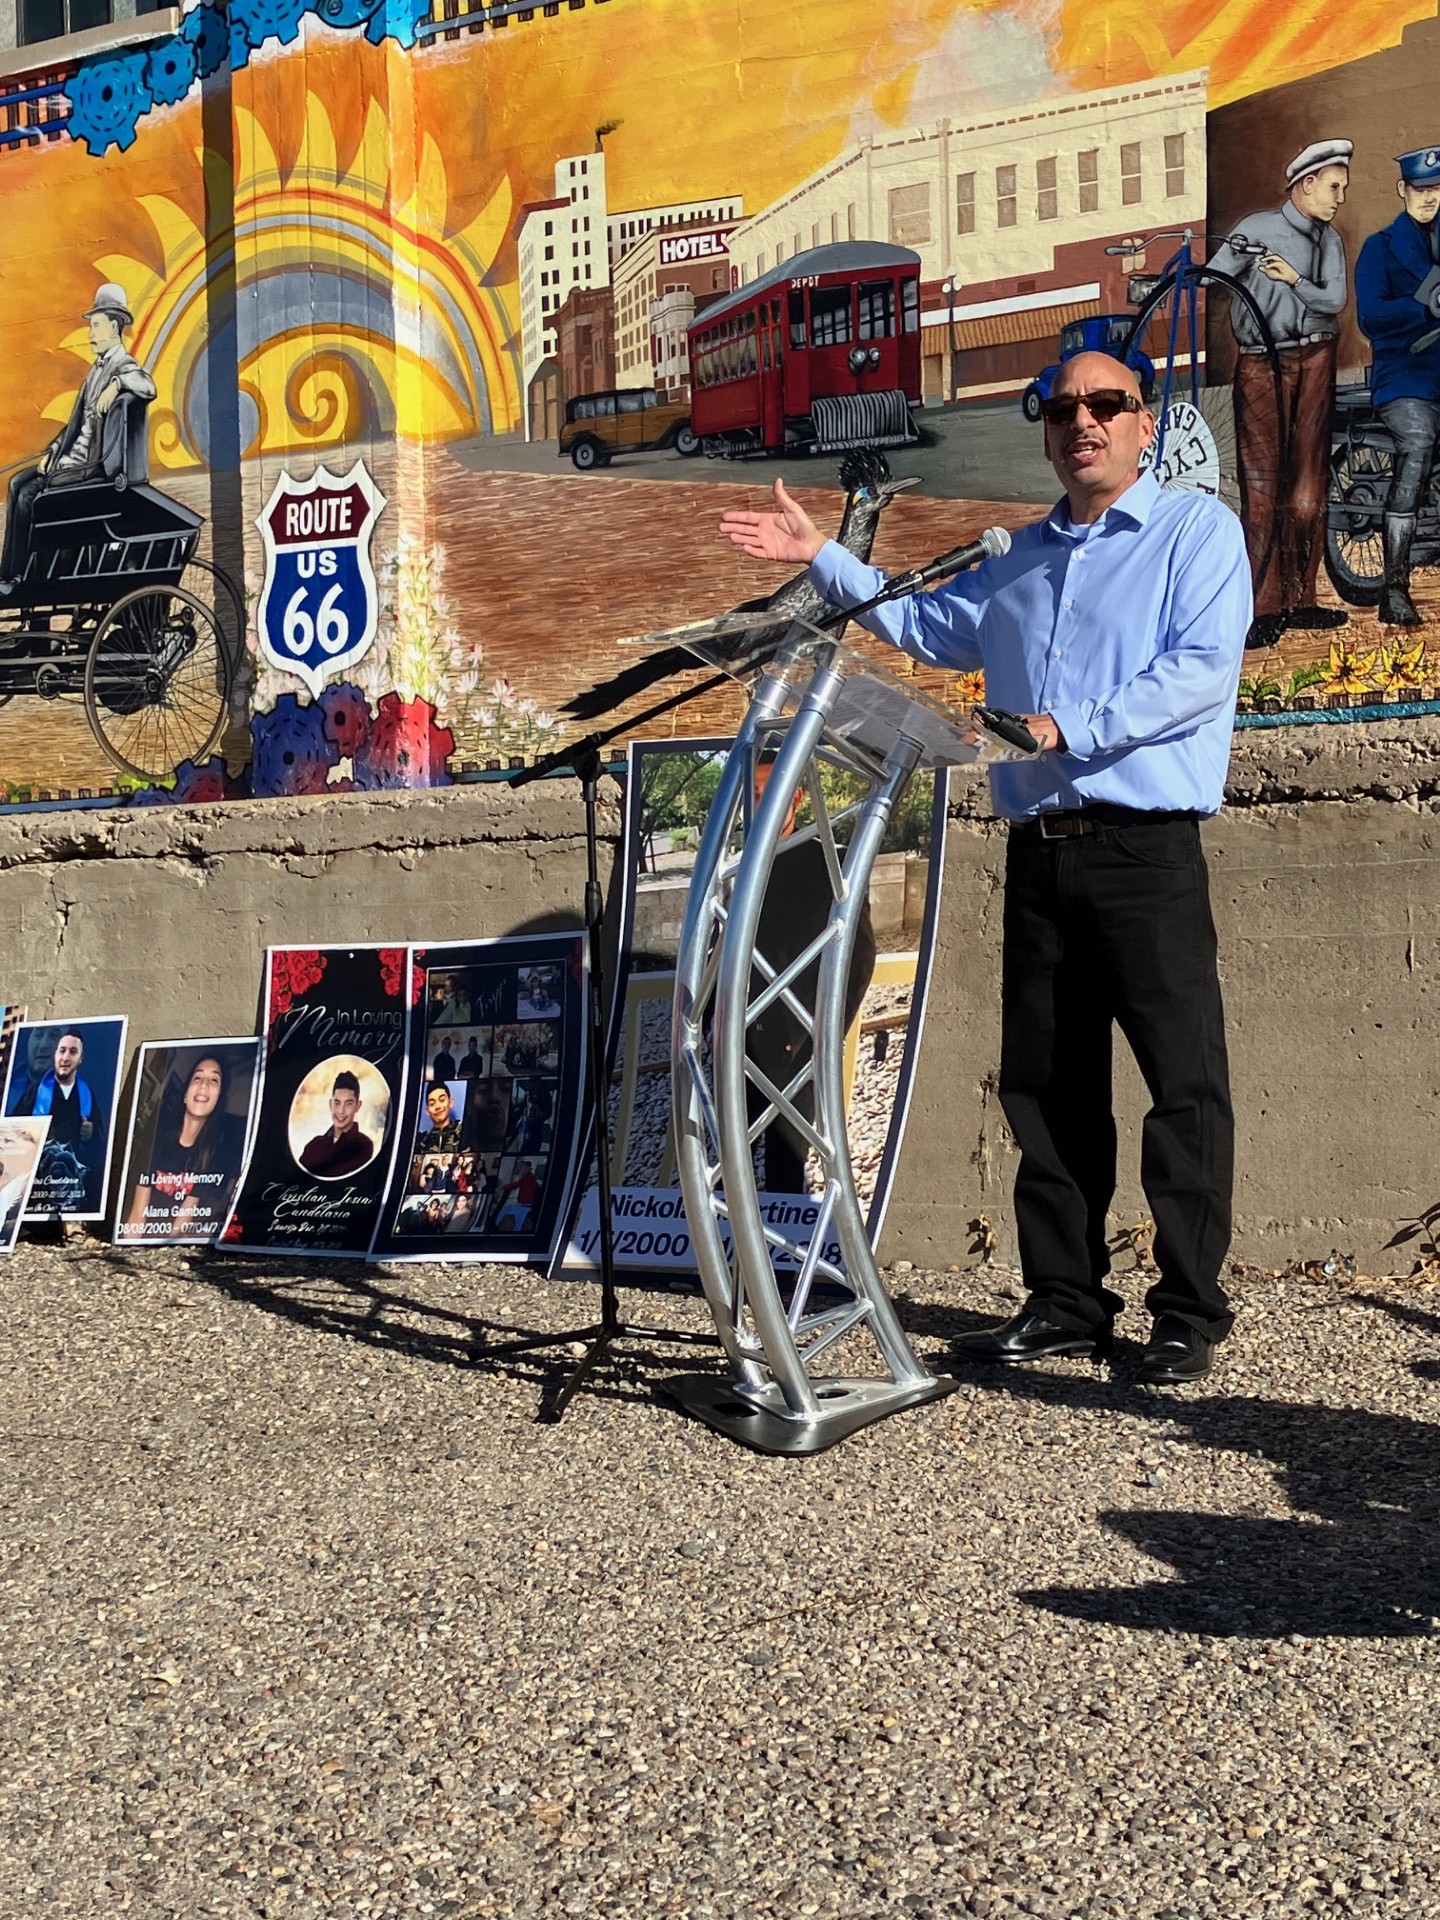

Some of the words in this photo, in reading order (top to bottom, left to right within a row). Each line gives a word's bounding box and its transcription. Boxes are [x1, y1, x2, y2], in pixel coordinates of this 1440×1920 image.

[662, 233, 723, 262] HOTEL
[791, 275, 820, 289] DEPOT
[286, 496, 353, 536] ROUTE
[297, 550, 338, 578] US
[283, 582, 349, 656] 66
[337, 1009, 349, 1025] In
[353, 1009, 402, 1029] Loving
[279, 1004, 402, 1065] Memory
[140, 1173, 150, 1184] In
[151, 1172, 183, 1185] Loving
[184, 1172, 224, 1186] Memory
[175, 1188, 186, 1200] of
[142, 1205, 169, 1217] Alana
[171, 1205, 212, 1217] Gamboa
